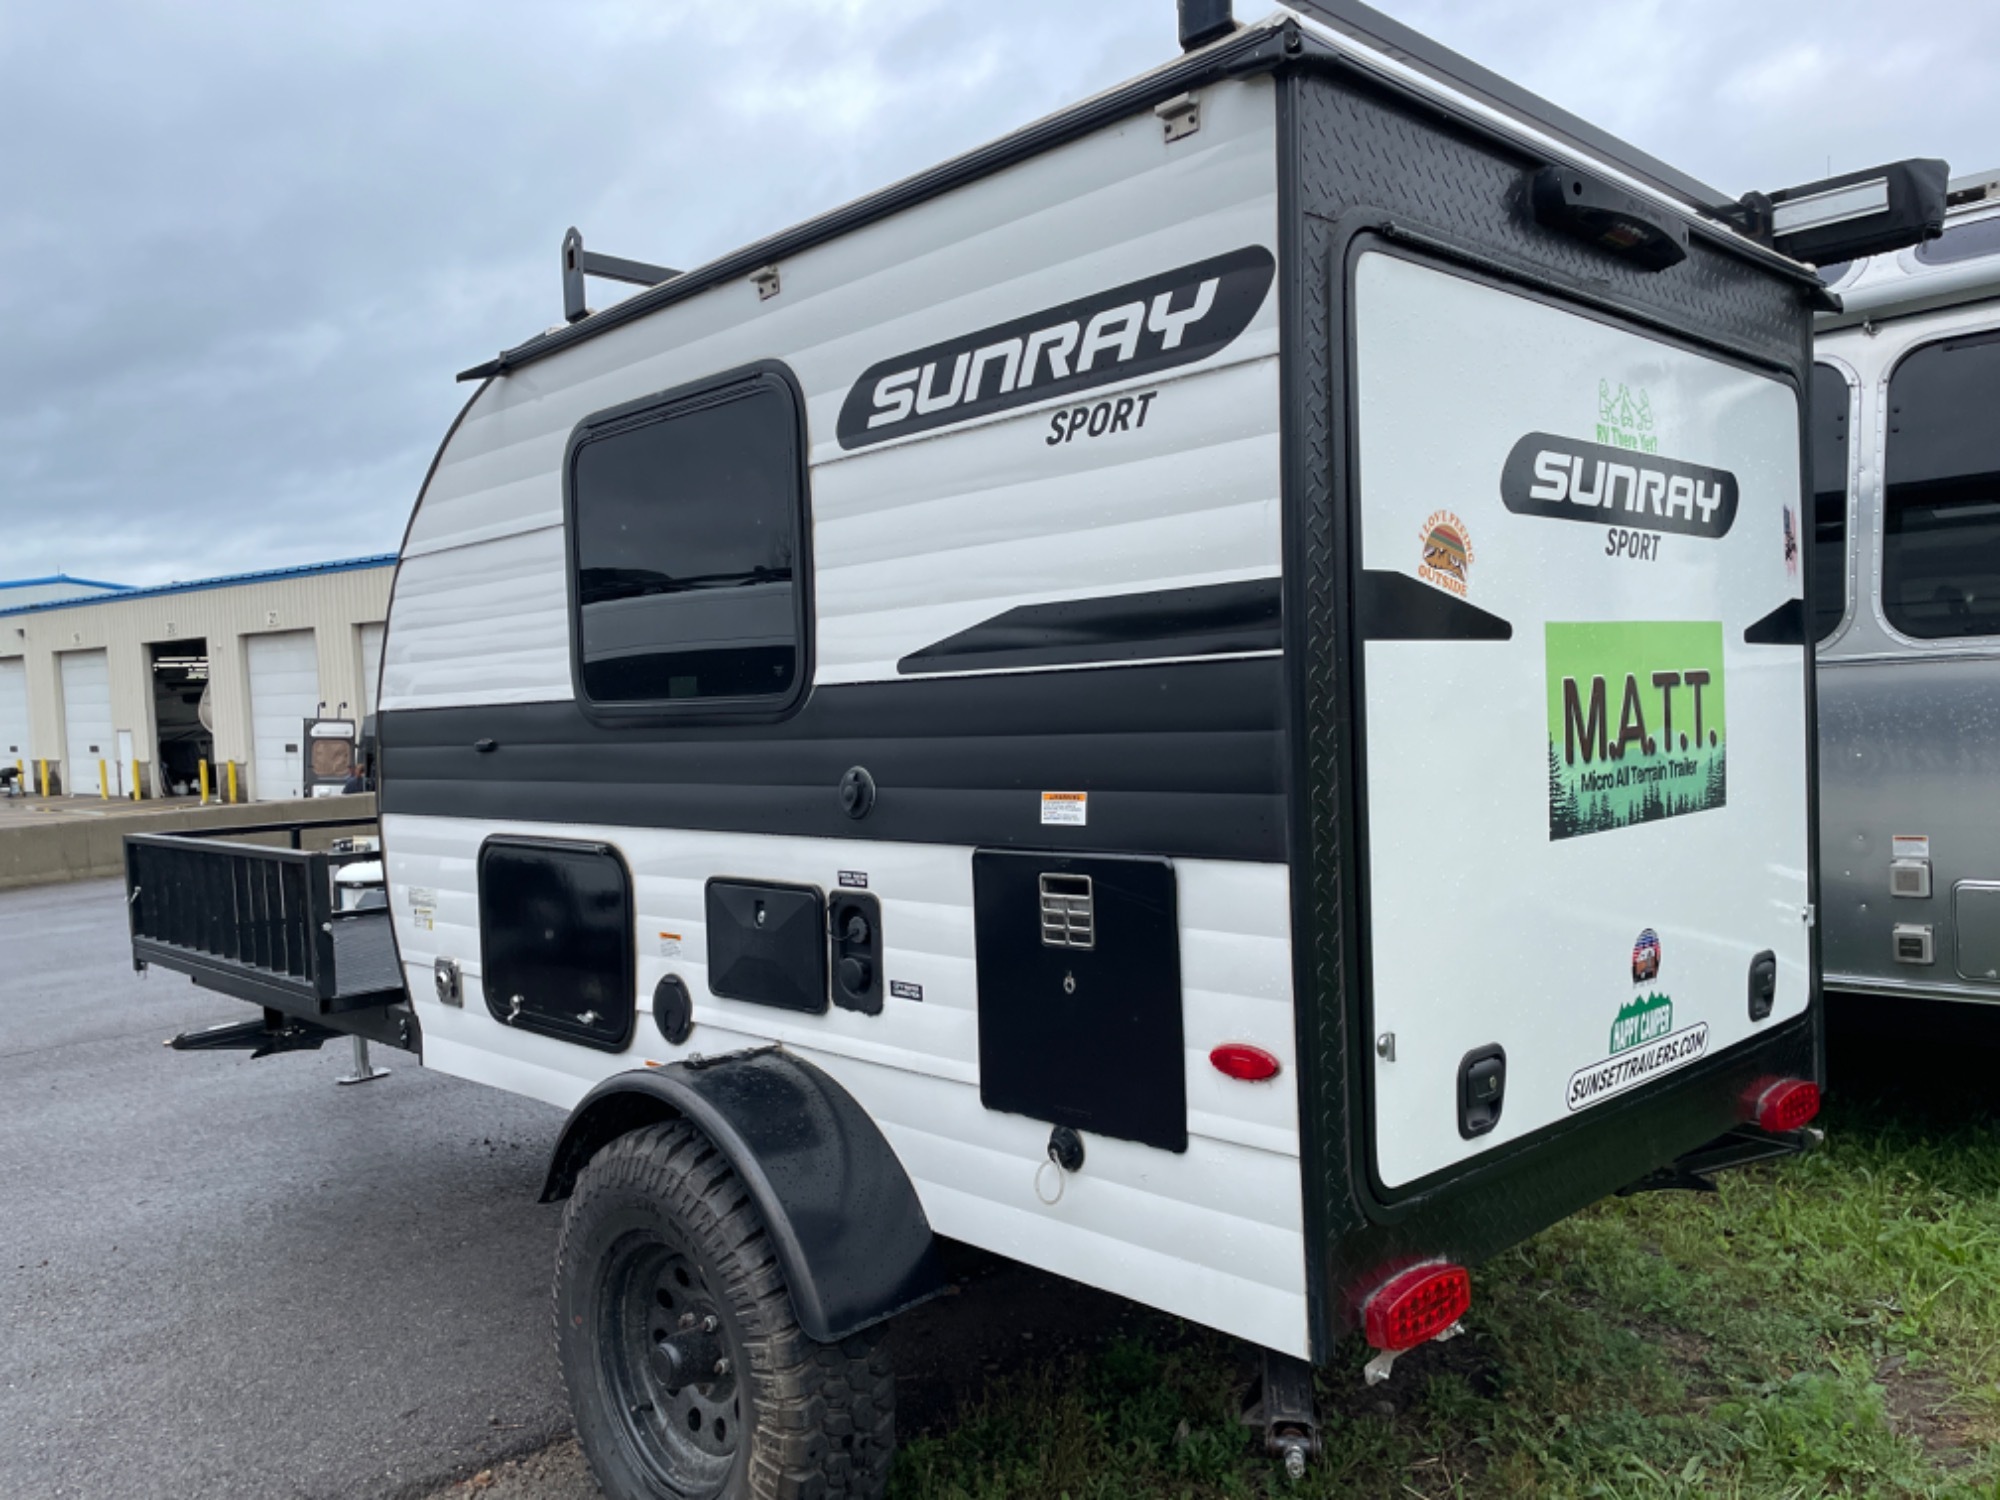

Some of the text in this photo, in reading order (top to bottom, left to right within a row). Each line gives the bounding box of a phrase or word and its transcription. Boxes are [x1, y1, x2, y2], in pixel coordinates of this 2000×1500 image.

[868, 277, 1220, 429] SUNRAY
[1046, 390, 1157, 445] SPORT
[1596, 422, 1610, 444] RV
[1611, 425, 1637, 449] There
[1529, 450, 1721, 523] SUNRAY
[1423, 510, 1447, 534] LOVE
[1605, 528, 1661, 561] SPORT
[1418, 564, 1467, 598] OUTSIDE
[1562, 669, 1717, 766] M.A.T.T.
[1581, 757, 1698, 792] Micro All Terrain Trailer
[1612, 1003, 1671, 1052] HAPPY CAMPER
[1571, 1031, 1706, 1102] SUNSETTRAILERS.COM
